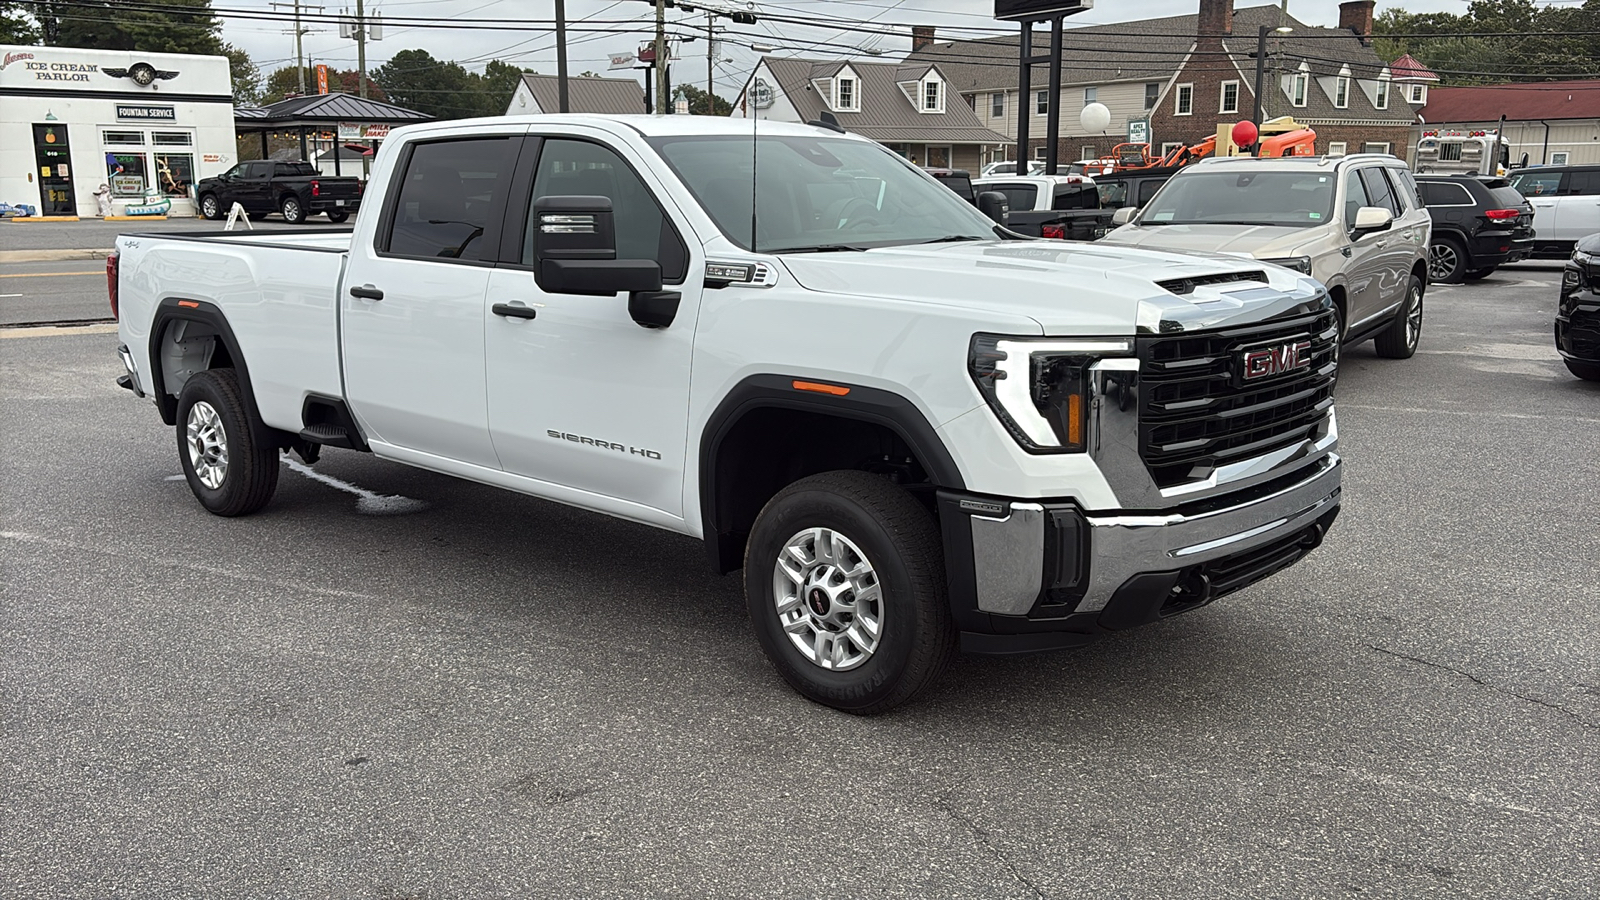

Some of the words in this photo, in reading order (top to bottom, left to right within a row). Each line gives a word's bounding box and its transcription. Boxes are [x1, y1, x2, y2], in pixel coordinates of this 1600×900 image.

[26, 62, 47, 70] ICE
[51, 63, 98, 72] CREAM
[36, 72, 89, 82] PARLOR
[119, 108, 148, 117] FOUNTAIN
[149, 109, 173, 117] SERVICE
[1243, 341, 1311, 379] GMC
[546, 429, 625, 452] SIERRA
[629, 446, 661, 460] HD
